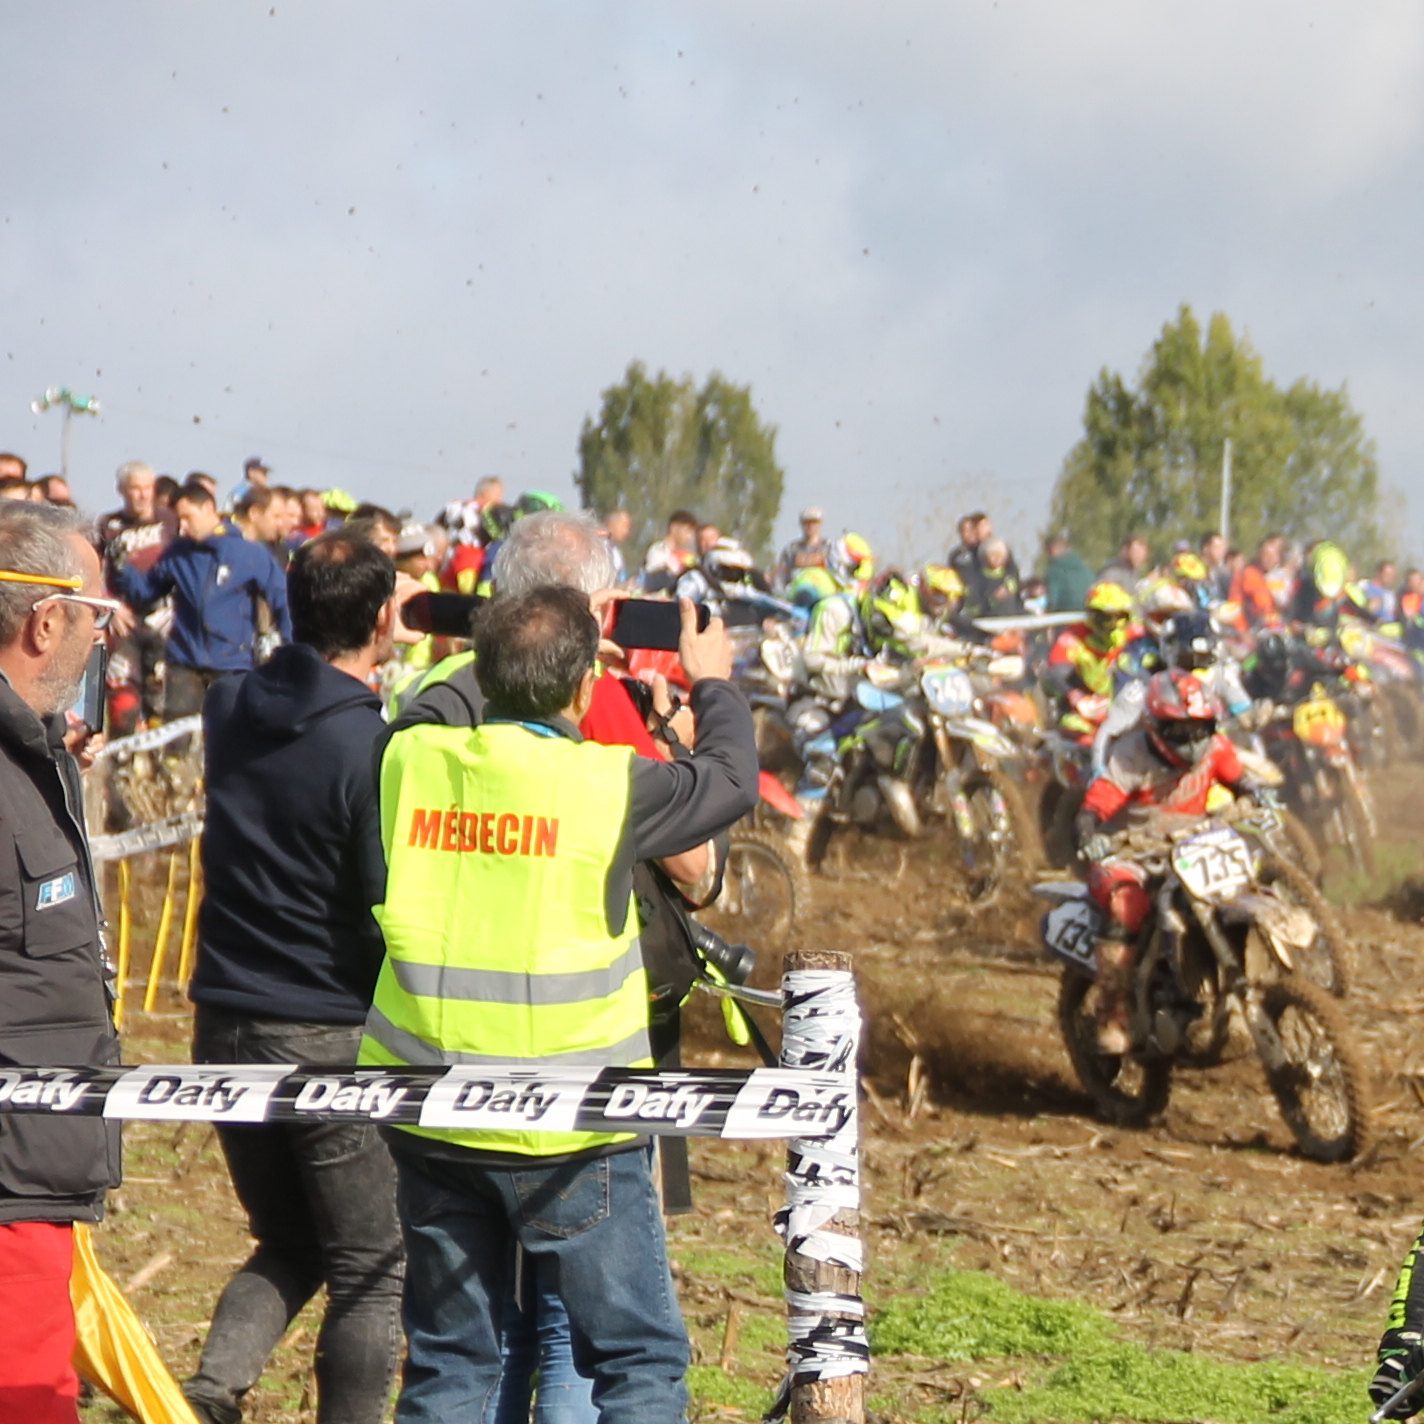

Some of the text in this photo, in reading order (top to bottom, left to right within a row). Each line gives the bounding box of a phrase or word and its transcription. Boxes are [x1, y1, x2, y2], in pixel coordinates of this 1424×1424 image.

[407, 803, 559, 858] MÉDECIN
[137, 1075, 251, 1113] Dafy
[294, 1076, 408, 1118] Dafy
[452, 1080, 561, 1122] Dafy
[603, 1082, 715, 1128] Dafy
[756, 1087, 856, 1134] Dafy
